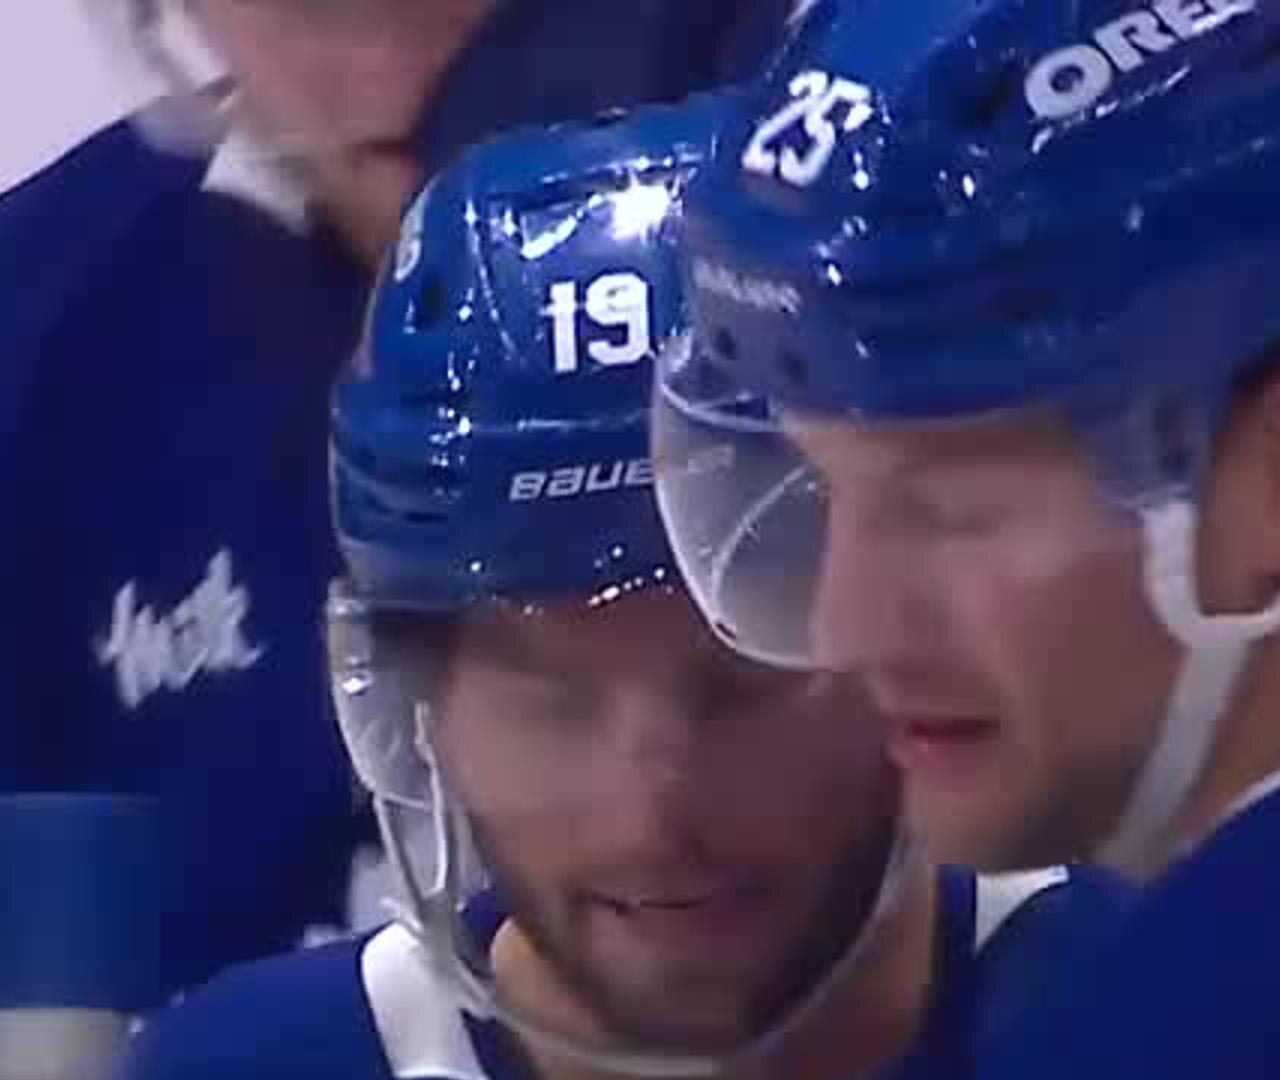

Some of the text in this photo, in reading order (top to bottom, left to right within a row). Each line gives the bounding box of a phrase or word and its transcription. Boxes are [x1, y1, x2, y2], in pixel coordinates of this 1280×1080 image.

[1023, 0, 1257, 119] ORE
[741, 70, 872, 187] 25
[545, 272, 654, 373] 19
[509, 455, 680, 500] BAUE
